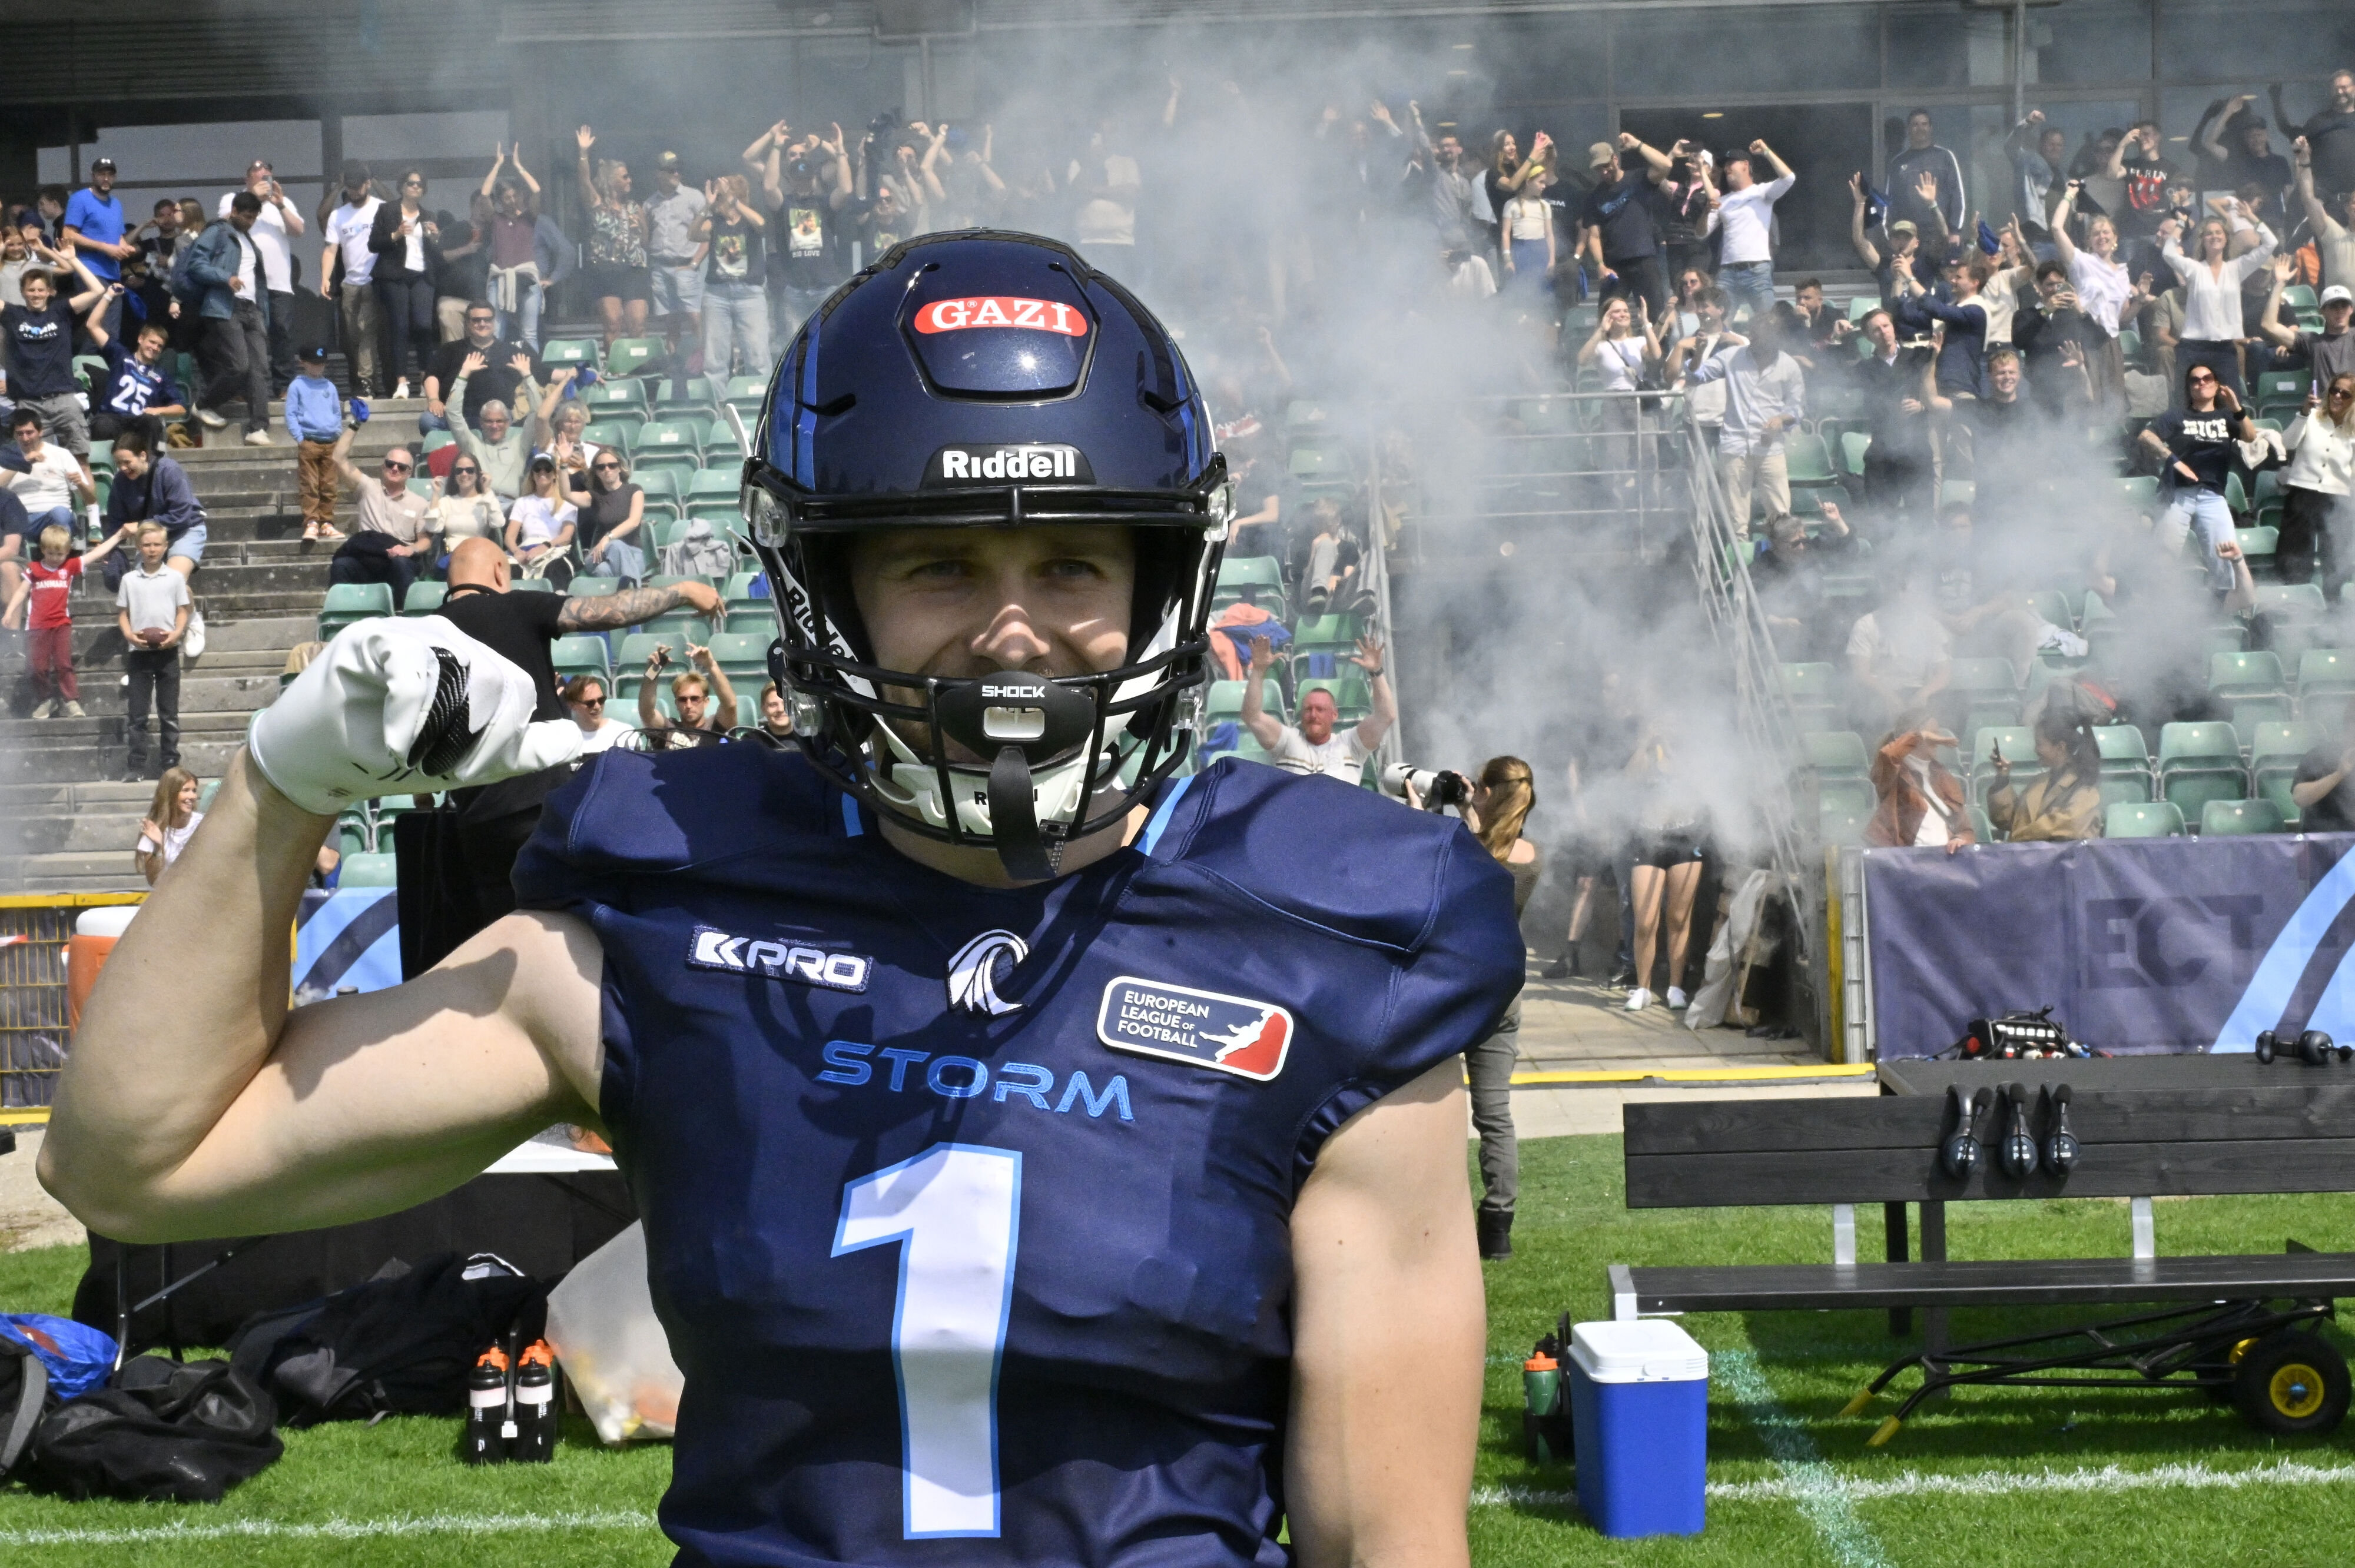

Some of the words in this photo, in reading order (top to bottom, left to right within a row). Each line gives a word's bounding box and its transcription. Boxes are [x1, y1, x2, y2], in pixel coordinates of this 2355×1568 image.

[111, 374, 152, 416] 25
[943, 450, 1076, 478] Riddell
[981, 685, 1045, 697] SHOCK
[1121, 1005, 1181, 1029] LEAGUE
[1182, 1022, 1195, 1031] OF
[1124, 990, 1209, 1019] EUROPEAN
[1117, 1020, 1198, 1048] FOOTBALL
[814, 1039, 1134, 1121] STORM
[831, 1142, 1023, 1540] 1
